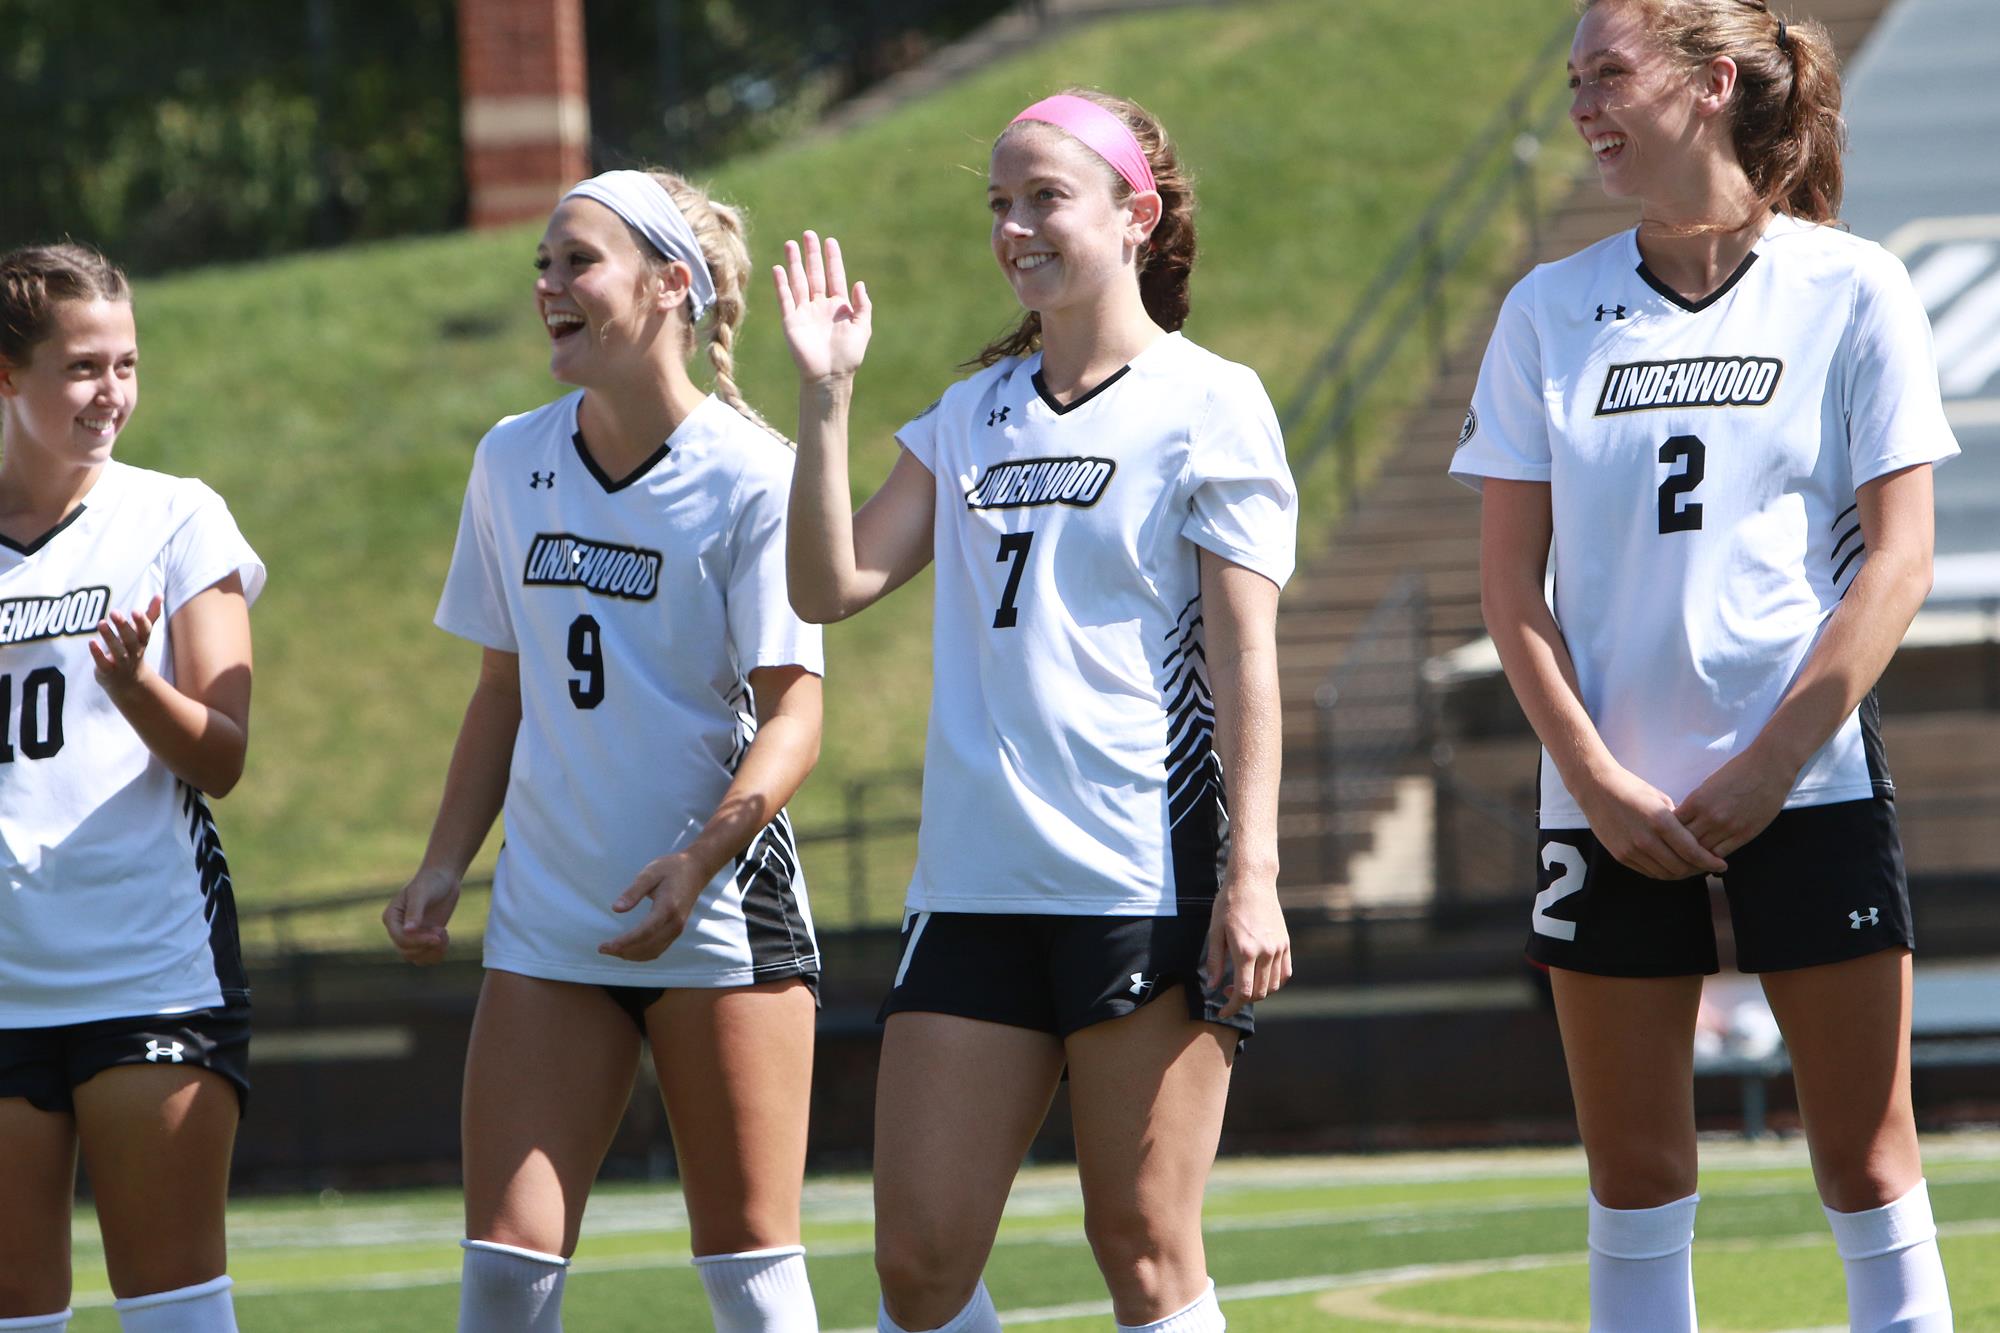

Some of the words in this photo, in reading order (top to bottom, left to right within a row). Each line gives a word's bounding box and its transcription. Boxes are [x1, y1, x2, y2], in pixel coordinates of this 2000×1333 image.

[1601, 361, 1778, 411] LINDENWOOD
[967, 460, 1111, 506] LINDENWOOD
[1658, 435, 1706, 534] 2
[0, 588, 106, 643] ENWOOD
[993, 531, 1034, 628] 7
[567, 614, 604, 709] 9
[0, 666, 65, 763] 10
[1532, 841, 1587, 941] 2
